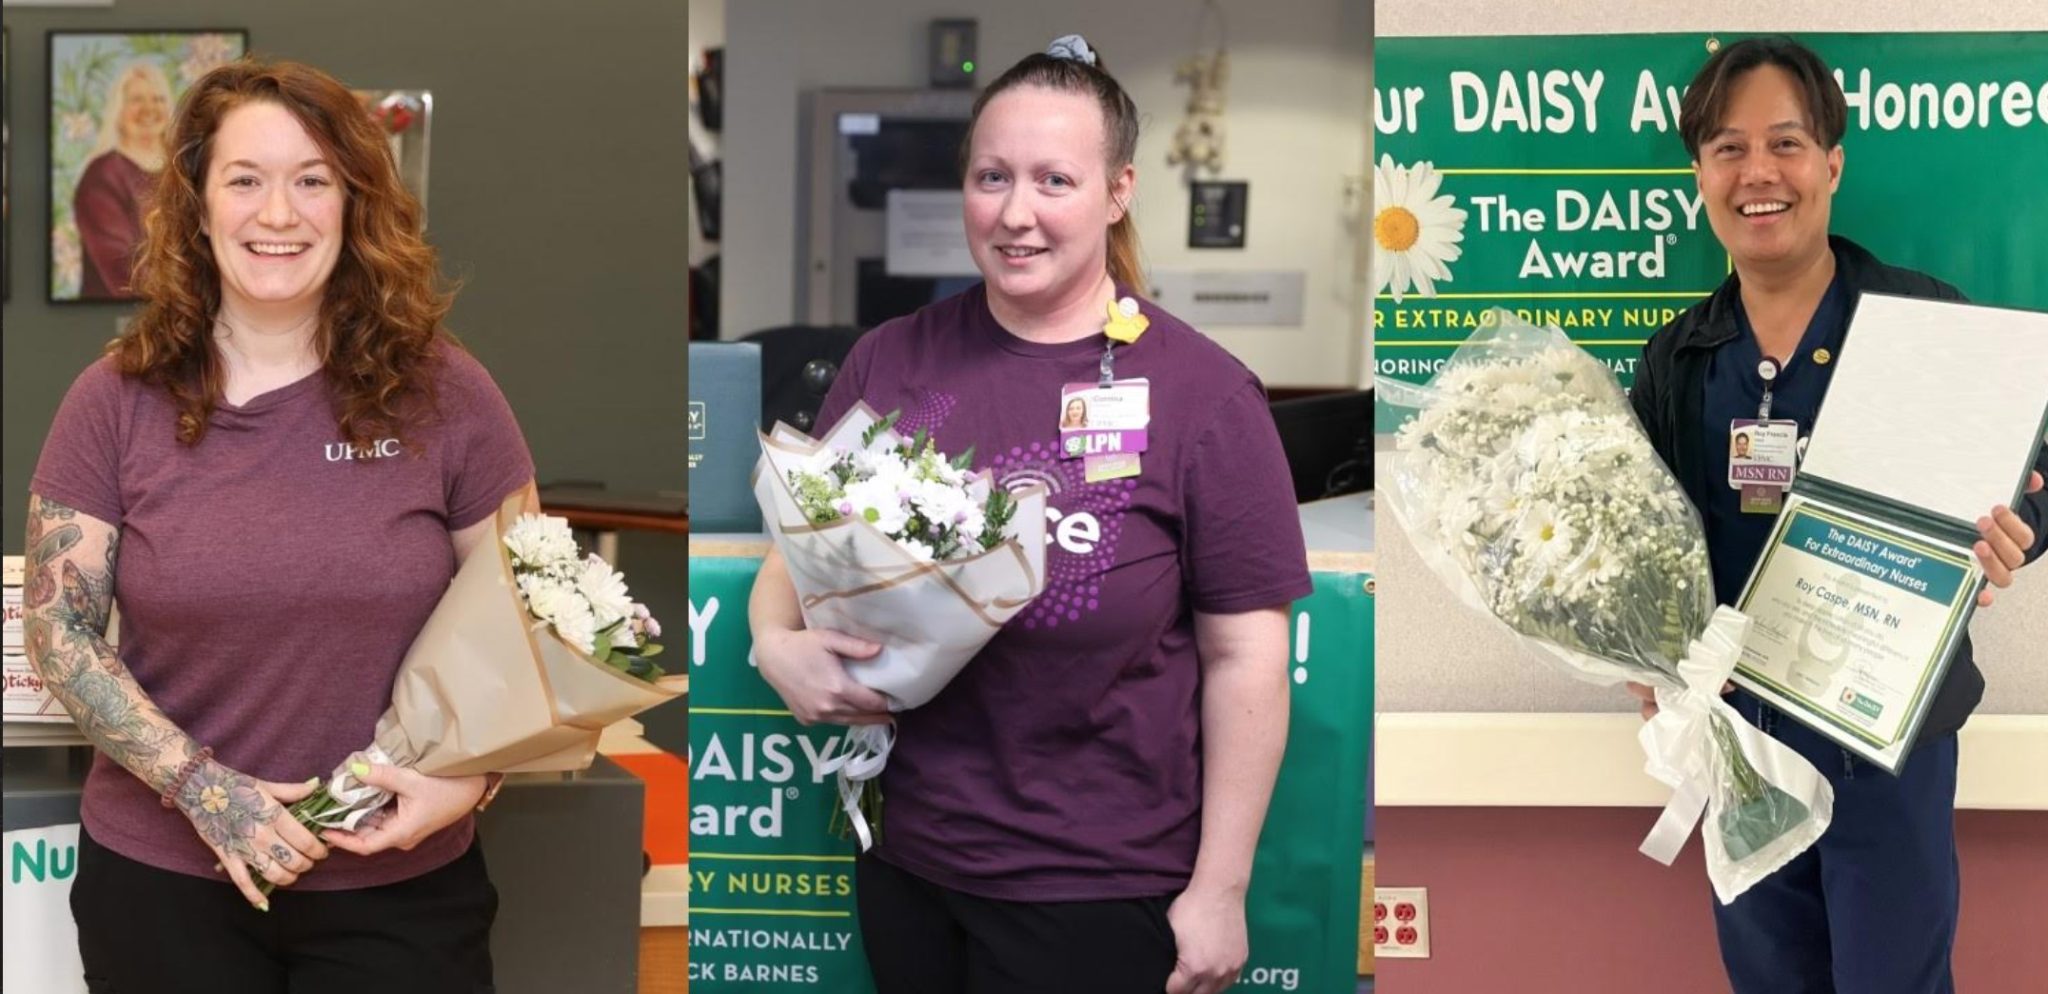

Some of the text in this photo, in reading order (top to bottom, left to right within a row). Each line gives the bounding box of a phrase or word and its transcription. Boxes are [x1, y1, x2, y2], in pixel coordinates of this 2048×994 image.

[1450, 69, 1604, 134] DAISY
[1471, 188, 1705, 232] The DAISY
[1395, 309, 1613, 328] EXTRAODINARY
[1623, 308, 1688, 327] NUR
[324, 438, 400, 461] UPMC
[1085, 431, 1122, 454] LPN
[1735, 465, 1788, 481] MSN RN
[1828, 527, 1845, 544] The
[1846, 534, 1879, 555] DAISY
[1804, 537, 1820, 551] For
[1820, 543, 1889, 580] Extraordinary
[1889, 568, 1928, 592] Nurses
[1795, 577, 1816, 594] Roy
[1883, 613, 1901, 629] RN
[4, 674, 44, 692] ticky
[689, 732, 841, 783] AISY
[728, 872, 851, 896] NURSES
[689, 928, 852, 951] NATIONALLY
[724, 963, 819, 984] BARNES
[1236, 967, 1299, 990] .org
